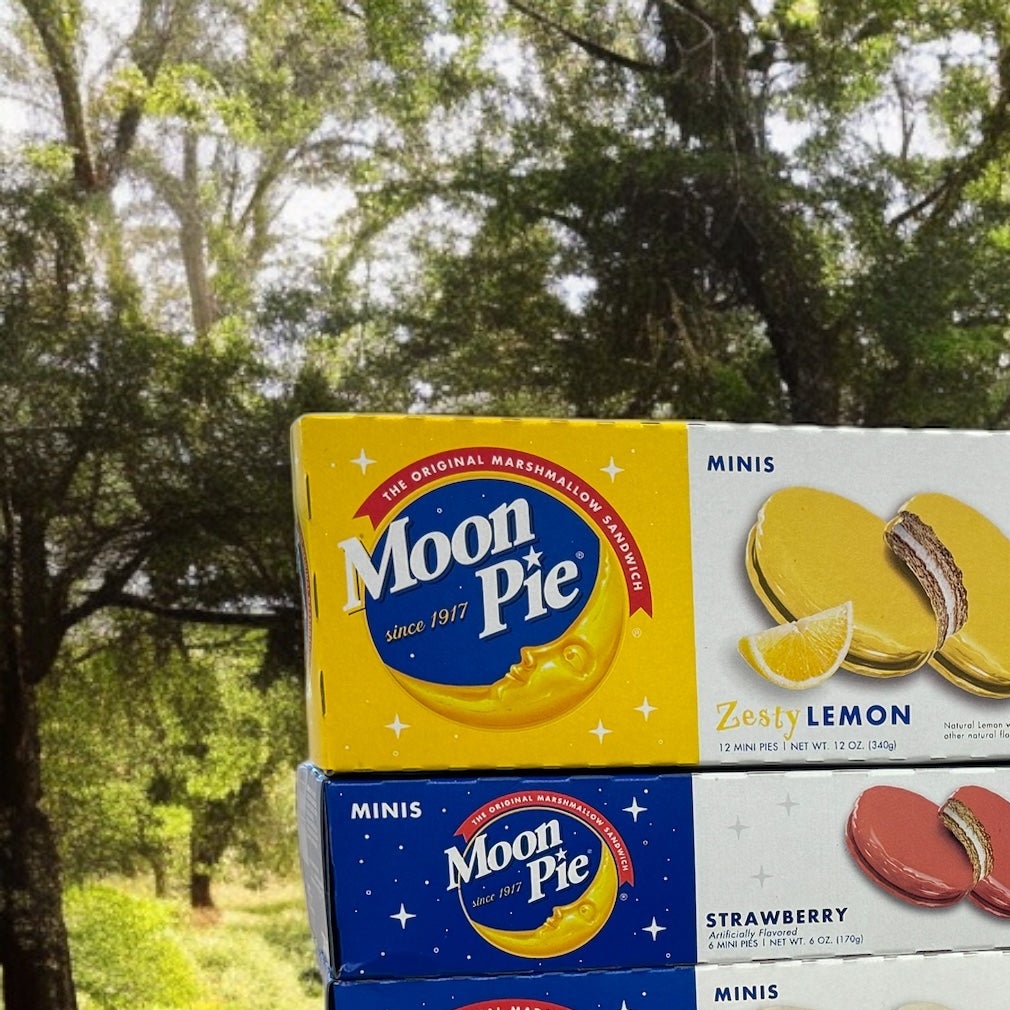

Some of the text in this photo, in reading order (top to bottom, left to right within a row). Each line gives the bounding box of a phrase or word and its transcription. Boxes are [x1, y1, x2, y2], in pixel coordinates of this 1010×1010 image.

[707, 455, 775, 472] MINIS
[382, 455, 643, 592] THE ORIGINAL MARSHMALLOW SANDWICH
[337, 497, 535, 613] Moon
[475, 546, 580, 640] Pie
[385, 601, 468, 642] since 1917
[716, 700, 910, 740] Zesty LEMON
[944, 731, 964, 739] other
[968, 730, 996, 739] natural
[719, 740, 897, 752] 12 MINI PIES NET WT. 12 OZ. (340g)
[351, 801, 422, 819] MINIS
[471, 795, 628, 872] THE ORIGINAL MARSHMALLOW SANDWICH
[444, 819, 563, 890] Moon
[526, 847, 590, 904] Pie
[706, 908, 847, 927] STRAWBERRY
[709, 928, 797, 942] Artificially Flavored
[717, 940, 737, 948] MINI
[741, 940, 758, 948] PIES
[770, 938, 785, 946] NET
[818, 936, 833, 944] OZ.
[836, 935, 863, 945] (170g)
[714, 984, 779, 1002] MINIS
